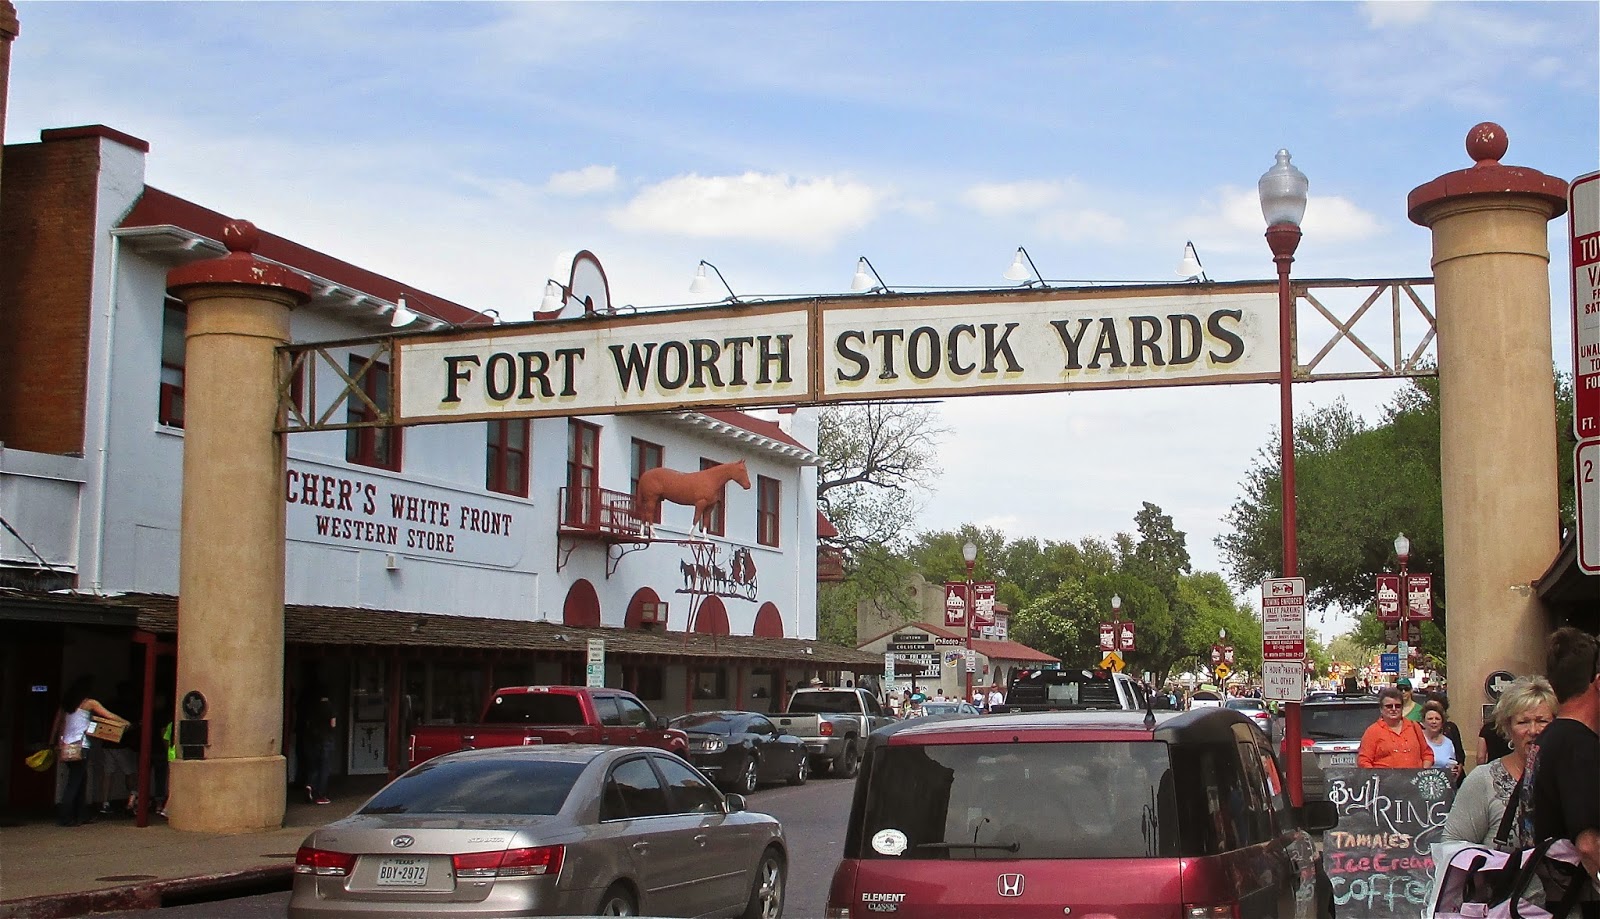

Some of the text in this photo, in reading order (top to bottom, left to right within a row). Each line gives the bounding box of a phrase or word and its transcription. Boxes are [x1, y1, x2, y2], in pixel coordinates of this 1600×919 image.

[1580, 235, 1600, 261] TO
[442, 309, 1245, 402] FORT WORTH STOCK YARDS
[1582, 417, 1597, 430] FT.
[1584, 460, 1593, 483] 2
[286, 469, 513, 536] CHER'S WHITE FRONT
[316, 514, 455, 553] WESTERN STORE
[862, 893, 906, 902] ELEMENT
